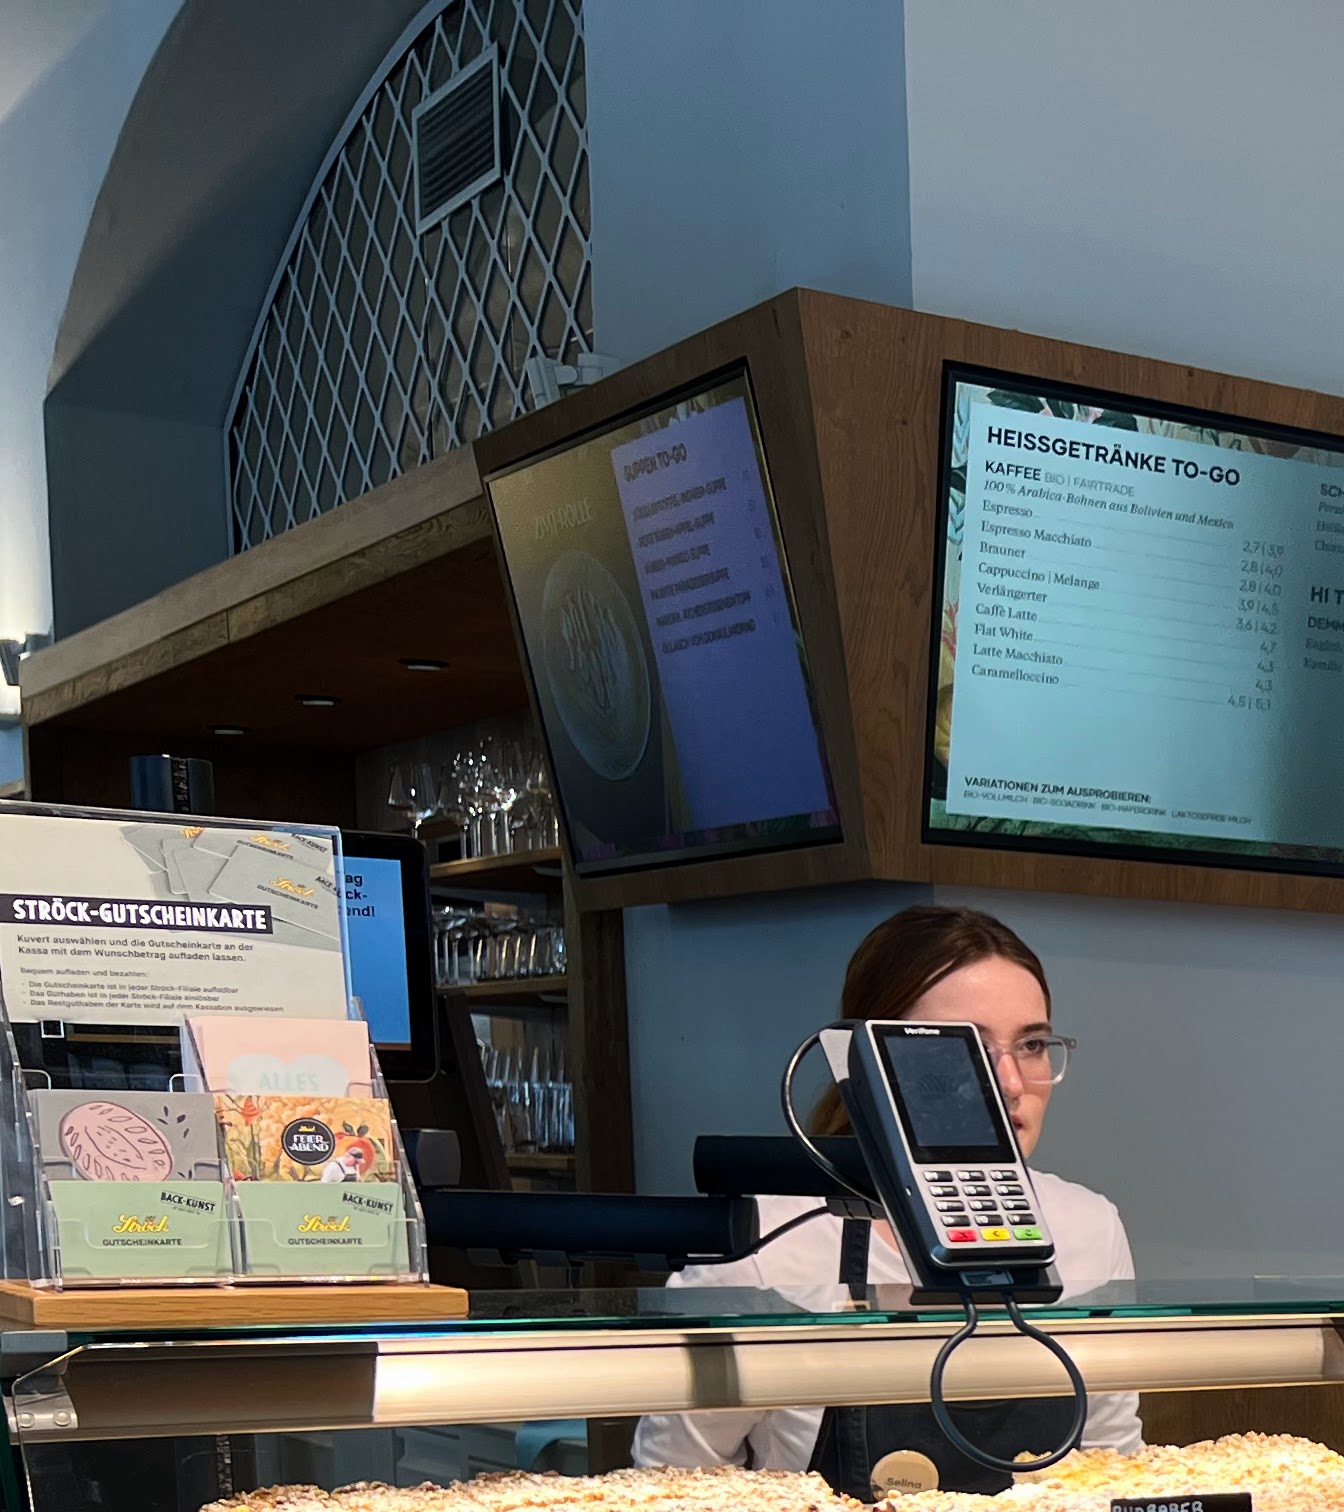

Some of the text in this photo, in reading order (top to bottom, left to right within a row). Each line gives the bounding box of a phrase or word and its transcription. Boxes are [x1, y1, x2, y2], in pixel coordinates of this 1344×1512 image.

[987, 426, 1240, 486] HEISSGETRÄNKE TO-GO
[985, 461, 1041, 481] KAFFEE
[1074, 477, 1135, 497] FAIRTRADE
[982, 500, 1033, 518] Espresso
[1109, 501, 1128, 514] aus
[1175, 511, 1195, 523] und
[981, 520, 1092, 548] Espresso Macchiato
[979, 541, 1025, 558] Brauner
[978, 562, 1100, 590] Cappuccino Melange
[977, 583, 1047, 602] Verlängerter
[1311, 586, 1329, 604] HI
[1008, 607, 1038, 621] Latte
[974, 623, 1033, 641] Flat White
[973, 644, 1063, 665] Latte Macchiato
[972, 664, 1059, 684] Caramelloccino
[964, 776, 1038, 793] VARIATIONEN
[1040, 784, 1064, 795] ZUM
[13, 898, 266, 930] STRÖCK-GUTSCHEINKARTE
[17, 935, 50, 943] Kuvert
[53, 936, 106, 946] auswählen
[109, 938, 127, 946] und
[130, 939, 145, 947] die
[148, 940, 221, 949] Gutscheinkarte
[238, 943, 254, 951] der
[18, 947, 48, 955] Kassa
[51, 947, 67, 955] mit
[70, 948, 91, 956] dem
[94, 949, 166, 960] Wunschbetrag
[260, 1072, 318, 1091] ALLES
[161, 1192, 215, 1211] BACK-KUNST
[103, 1238, 181, 1247] GUTSCHEINKARTE
[887, 1478, 922, 1488] Selina
